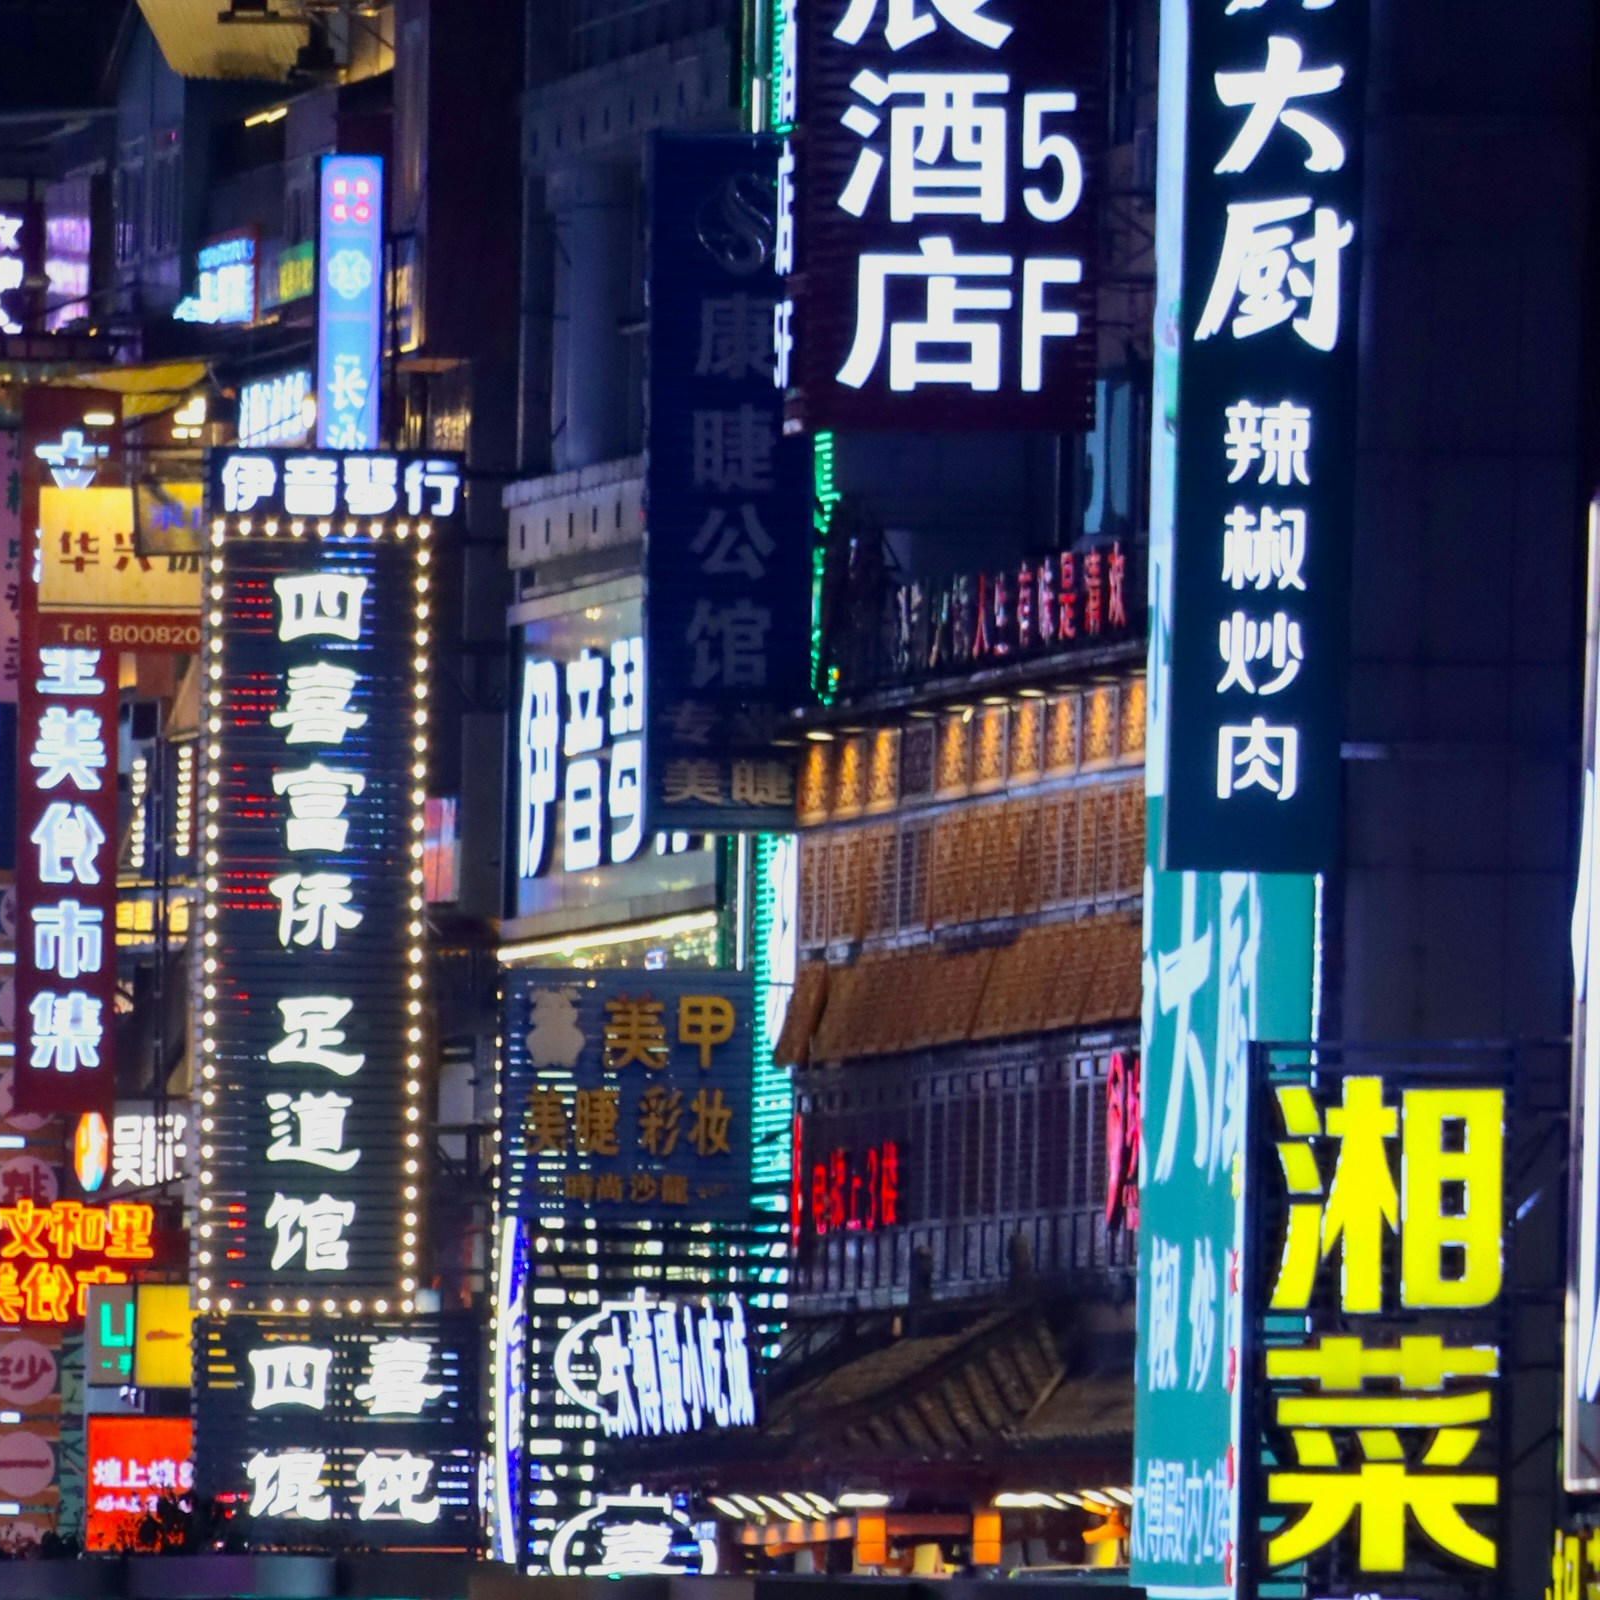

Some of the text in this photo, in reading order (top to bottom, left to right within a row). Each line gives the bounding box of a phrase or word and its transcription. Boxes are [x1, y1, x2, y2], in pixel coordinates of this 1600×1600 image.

[1019, 92, 1083, 393] 5F
[1195, 0, 1353, 353] 大厨
[221, 453, 461, 518] 伊音琴行
[1216, 400, 1312, 801] 辣椒炒肉
[603, 993, 736, 1071] 美甲
[248, 1338, 445, 1415] 四喜
[1266, 1076, 1504, 1572] 湘菜
[245, 1450, 442, 1522] 馄饨
